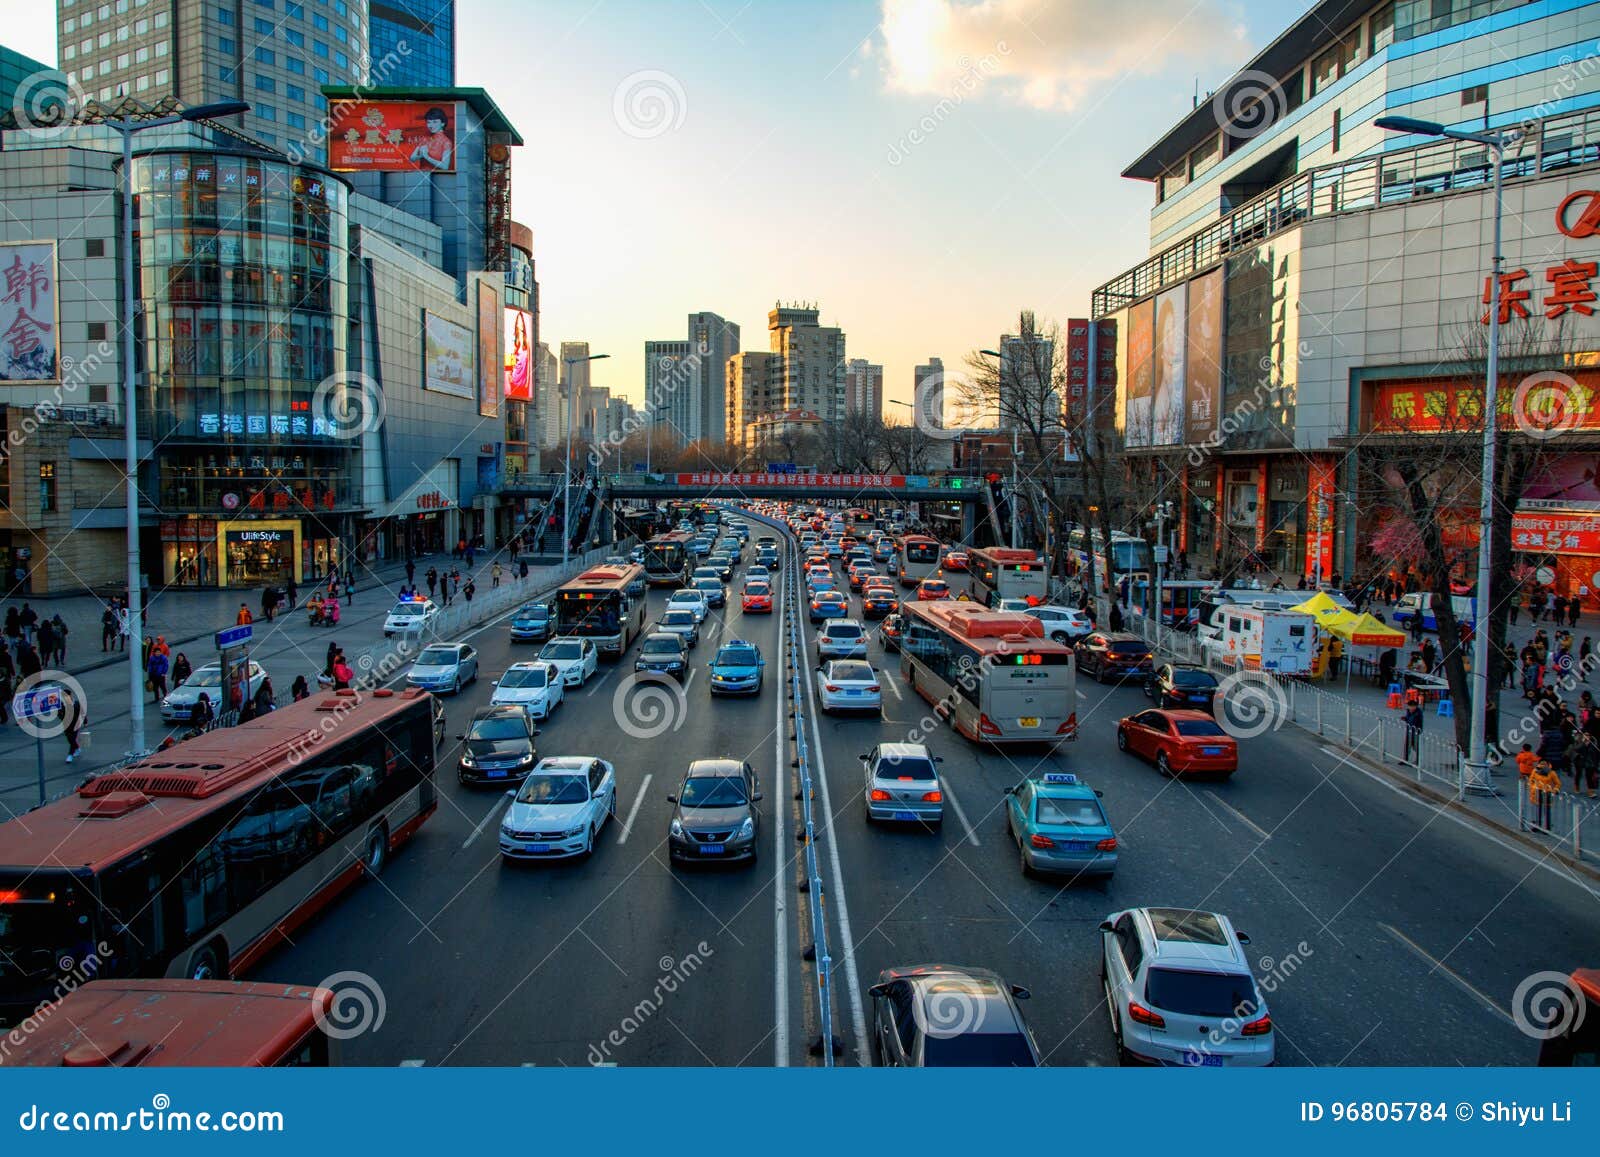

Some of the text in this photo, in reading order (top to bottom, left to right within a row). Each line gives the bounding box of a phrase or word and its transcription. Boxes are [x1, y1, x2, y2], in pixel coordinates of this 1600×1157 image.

[1480, 257, 1598, 326] 乐宾
[757, 474, 817, 485] 共享美好生活
[241, 531, 281, 542] UlifeStyle
